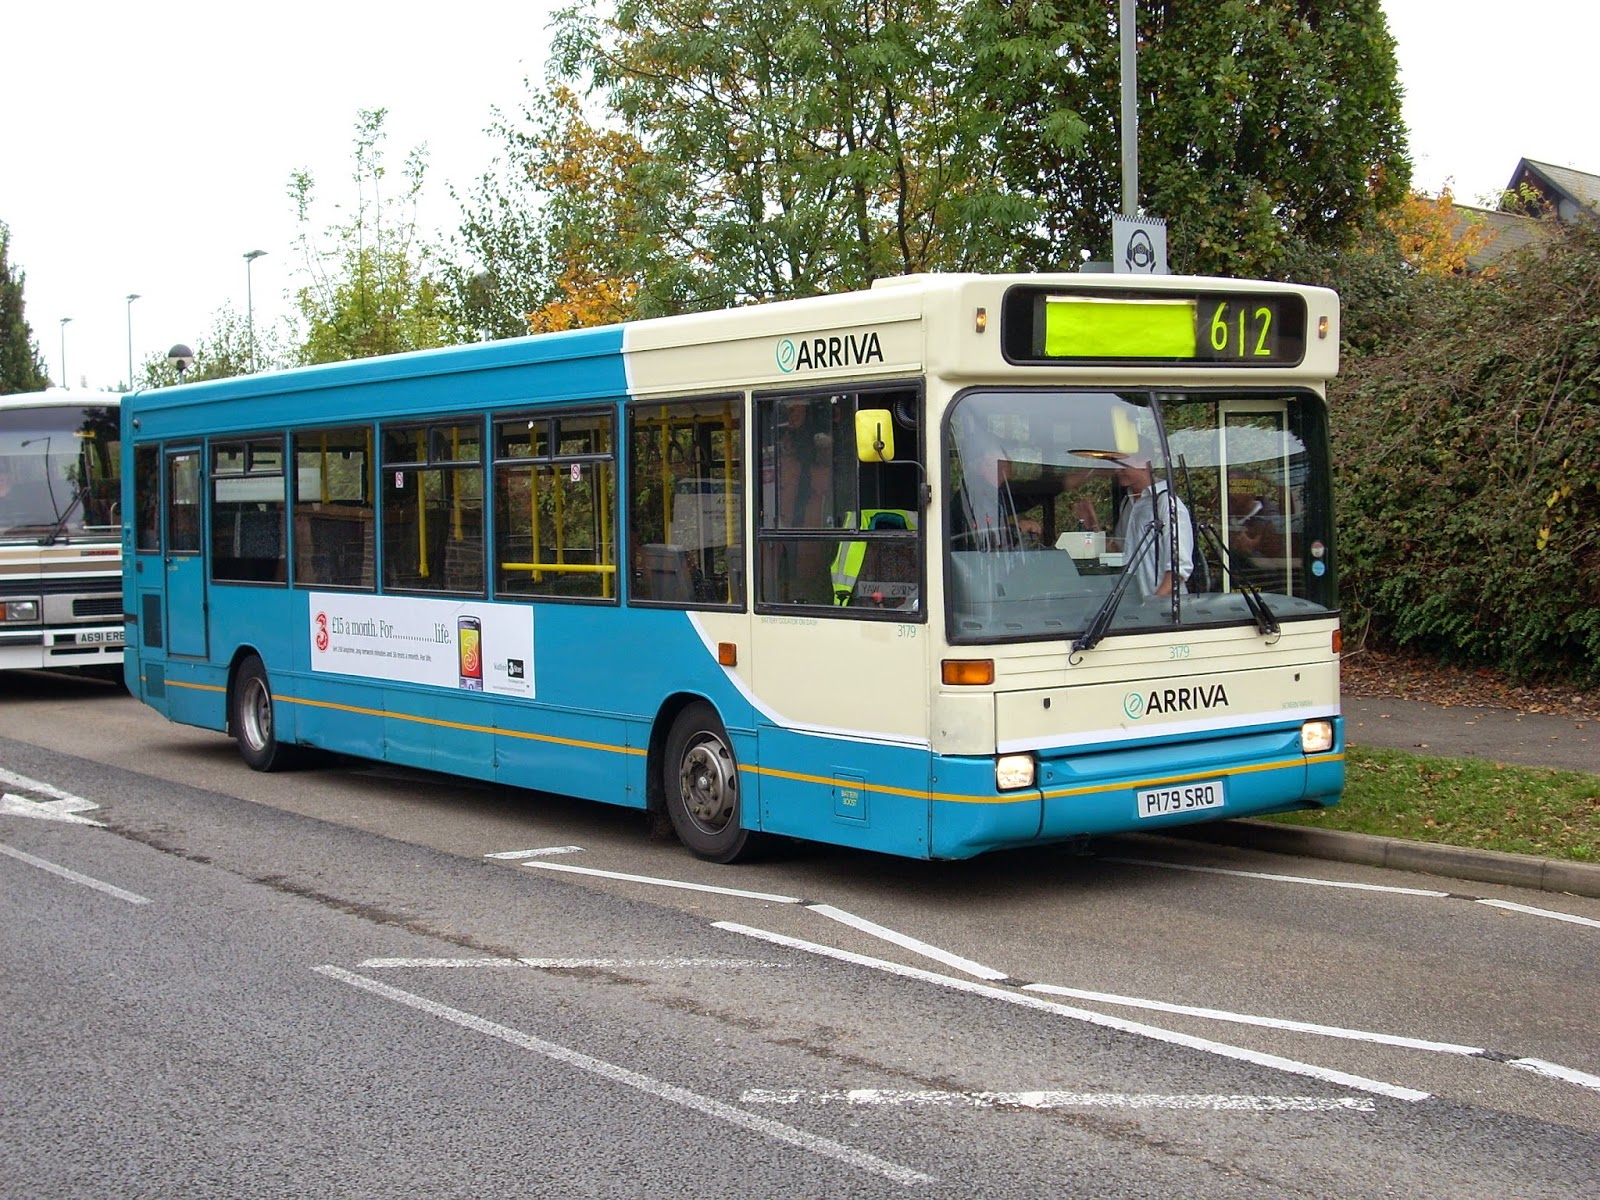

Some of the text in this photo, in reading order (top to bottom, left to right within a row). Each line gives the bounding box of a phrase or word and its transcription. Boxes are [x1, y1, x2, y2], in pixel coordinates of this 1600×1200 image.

[1210, 301, 1273, 357] 612
[795, 331, 884, 371] ARRIVA
[81, 633, 103, 642] A691
[332, 616, 344, 635] £15
[345, 621, 351, 635] a
[351, 618, 378, 638] month.
[898, 624, 917, 639] 3179
[1168, 644, 1191, 660] 3179
[1145, 684, 1229, 716] ARRIVA
[1146, 786, 1215, 813] P179 SRO
